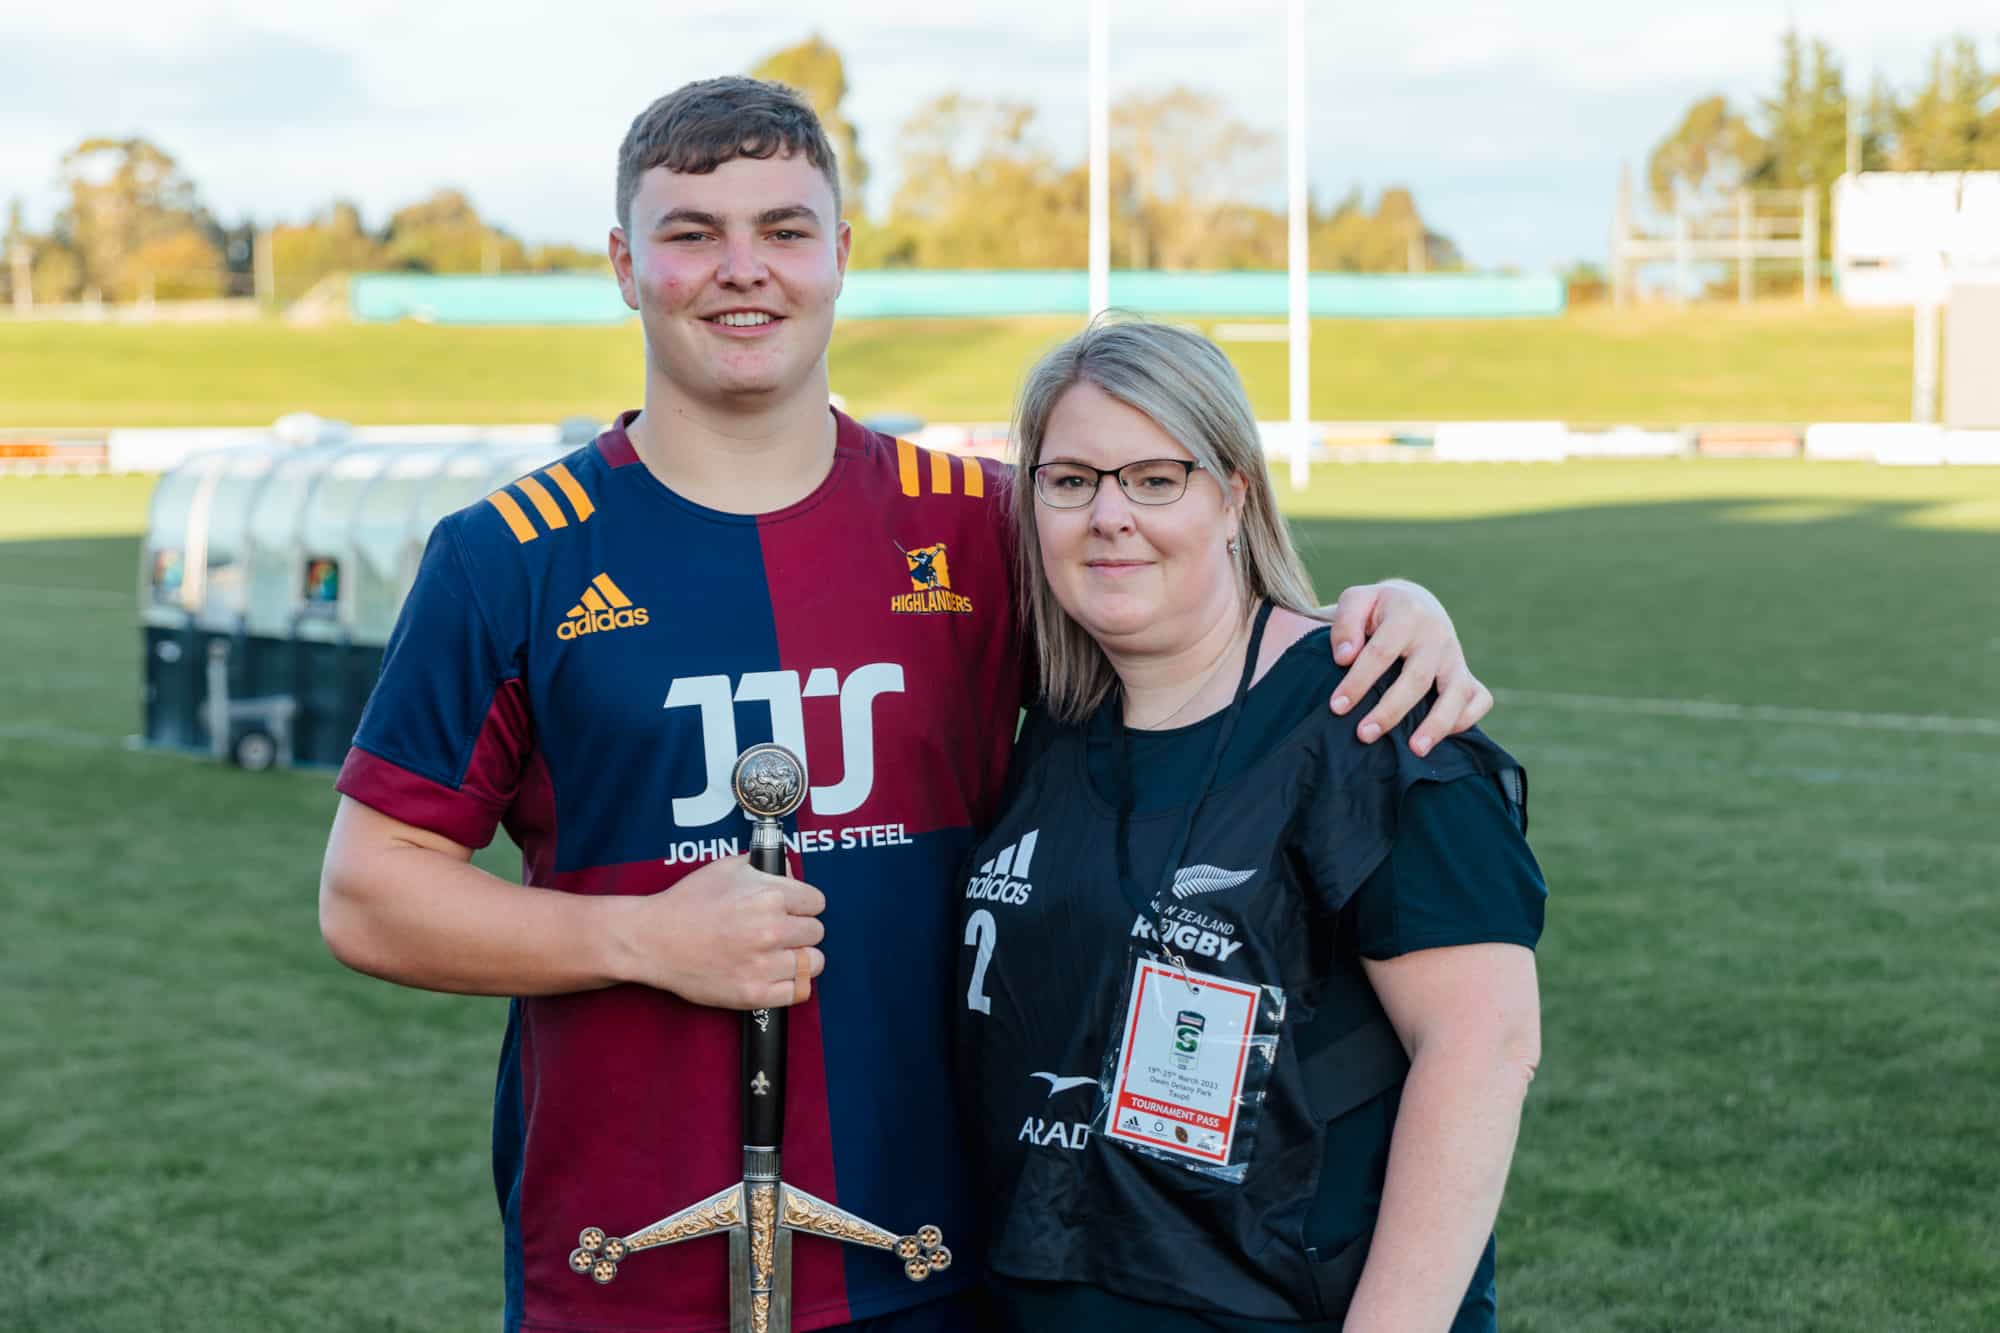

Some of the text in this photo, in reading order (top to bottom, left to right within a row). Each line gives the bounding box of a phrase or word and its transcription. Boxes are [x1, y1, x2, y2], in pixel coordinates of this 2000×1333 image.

[891, 590, 973, 612] HIGHLANDERS
[556, 607, 650, 640] adidas
[664, 823, 913, 865] JOHN NES STEEL
[965, 873, 1032, 905] adidas
[1177, 908, 1235, 935] ZEALAND
[964, 908, 997, 1015] 2
[1131, 1097, 1220, 1127] TOURNAMENT PASS
